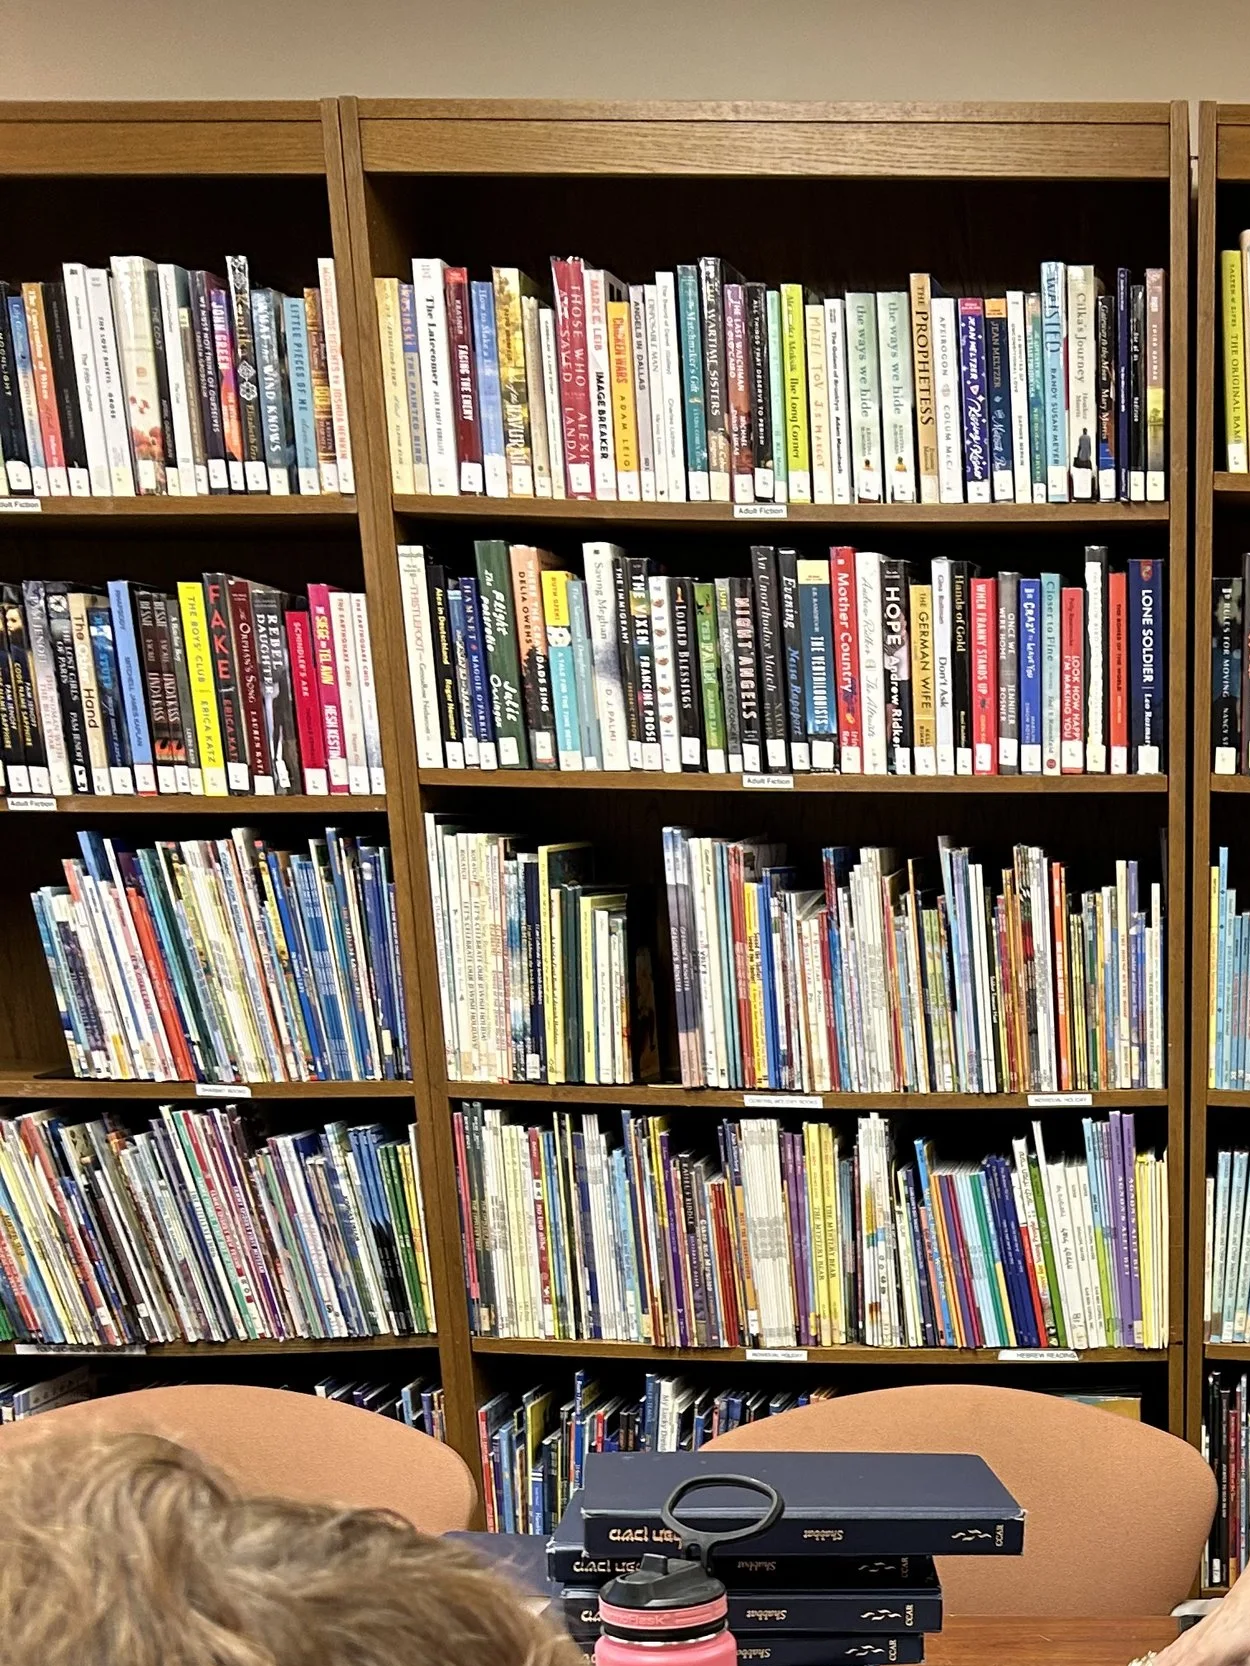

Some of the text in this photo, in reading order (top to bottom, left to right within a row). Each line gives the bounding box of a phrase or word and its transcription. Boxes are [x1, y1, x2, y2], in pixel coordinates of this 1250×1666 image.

[596, 372, 608, 459] IMAGE BREAKER
[738, 507, 783, 515] Adult Fiction
[463, 585, 476, 640] HAMNET
[519, 572, 532, 643] DELIA OWENS
[632, 575, 649, 645] THE VIXEN
[757, 552, 776, 691] An Unorthodox Match
[782, 576, 796, 629] Evening
[885, 587, 901, 645] HOPE
[1046, 581, 1056, 661] Closer to Fine
[267, 614, 282, 671] REBEL
[675, 605, 692, 709] LOADED BLESSINGS
[734, 598, 757, 719] NIGHT ANGELS
[837, 573, 852, 692] Mother Country
[918, 593, 931, 709] THE GERMAN WIFE
[976, 584, 988, 694] WHEN FRANNY STANDS UP
[1007, 613, 1015, 654] ONCE WE
[1141, 589, 1153, 682] LONE SOLDIER
[1222, 603, 1231, 698] RULES FOR MOVING
[640, 656, 657, 742] FRANCINE PROSE
[938, 657, 948, 708] Don't Ask
[1007, 684, 1016, 724] JENNIFER
[1064, 672, 1072, 712] MAKING
[201, 700, 216, 763] ERICA KATZ
[1064, 717, 1072, 737] YOU
[536, 1204, 542, 1215] no
[651, 1528, 684, 1550] תפל
[803, 1529, 844, 1541] Shabbat
[994, 1524, 1005, 1547] CCAR
[736, 1560, 777, 1572] Shabbat
[900, 1556, 909, 1578] CCAR
[746, 1609, 788, 1621] Shabbat
[905, 1604, 914, 1627] CCAR
[736, 1648, 771, 1660] Shabb
[888, 1639, 897, 1662] CCAR
